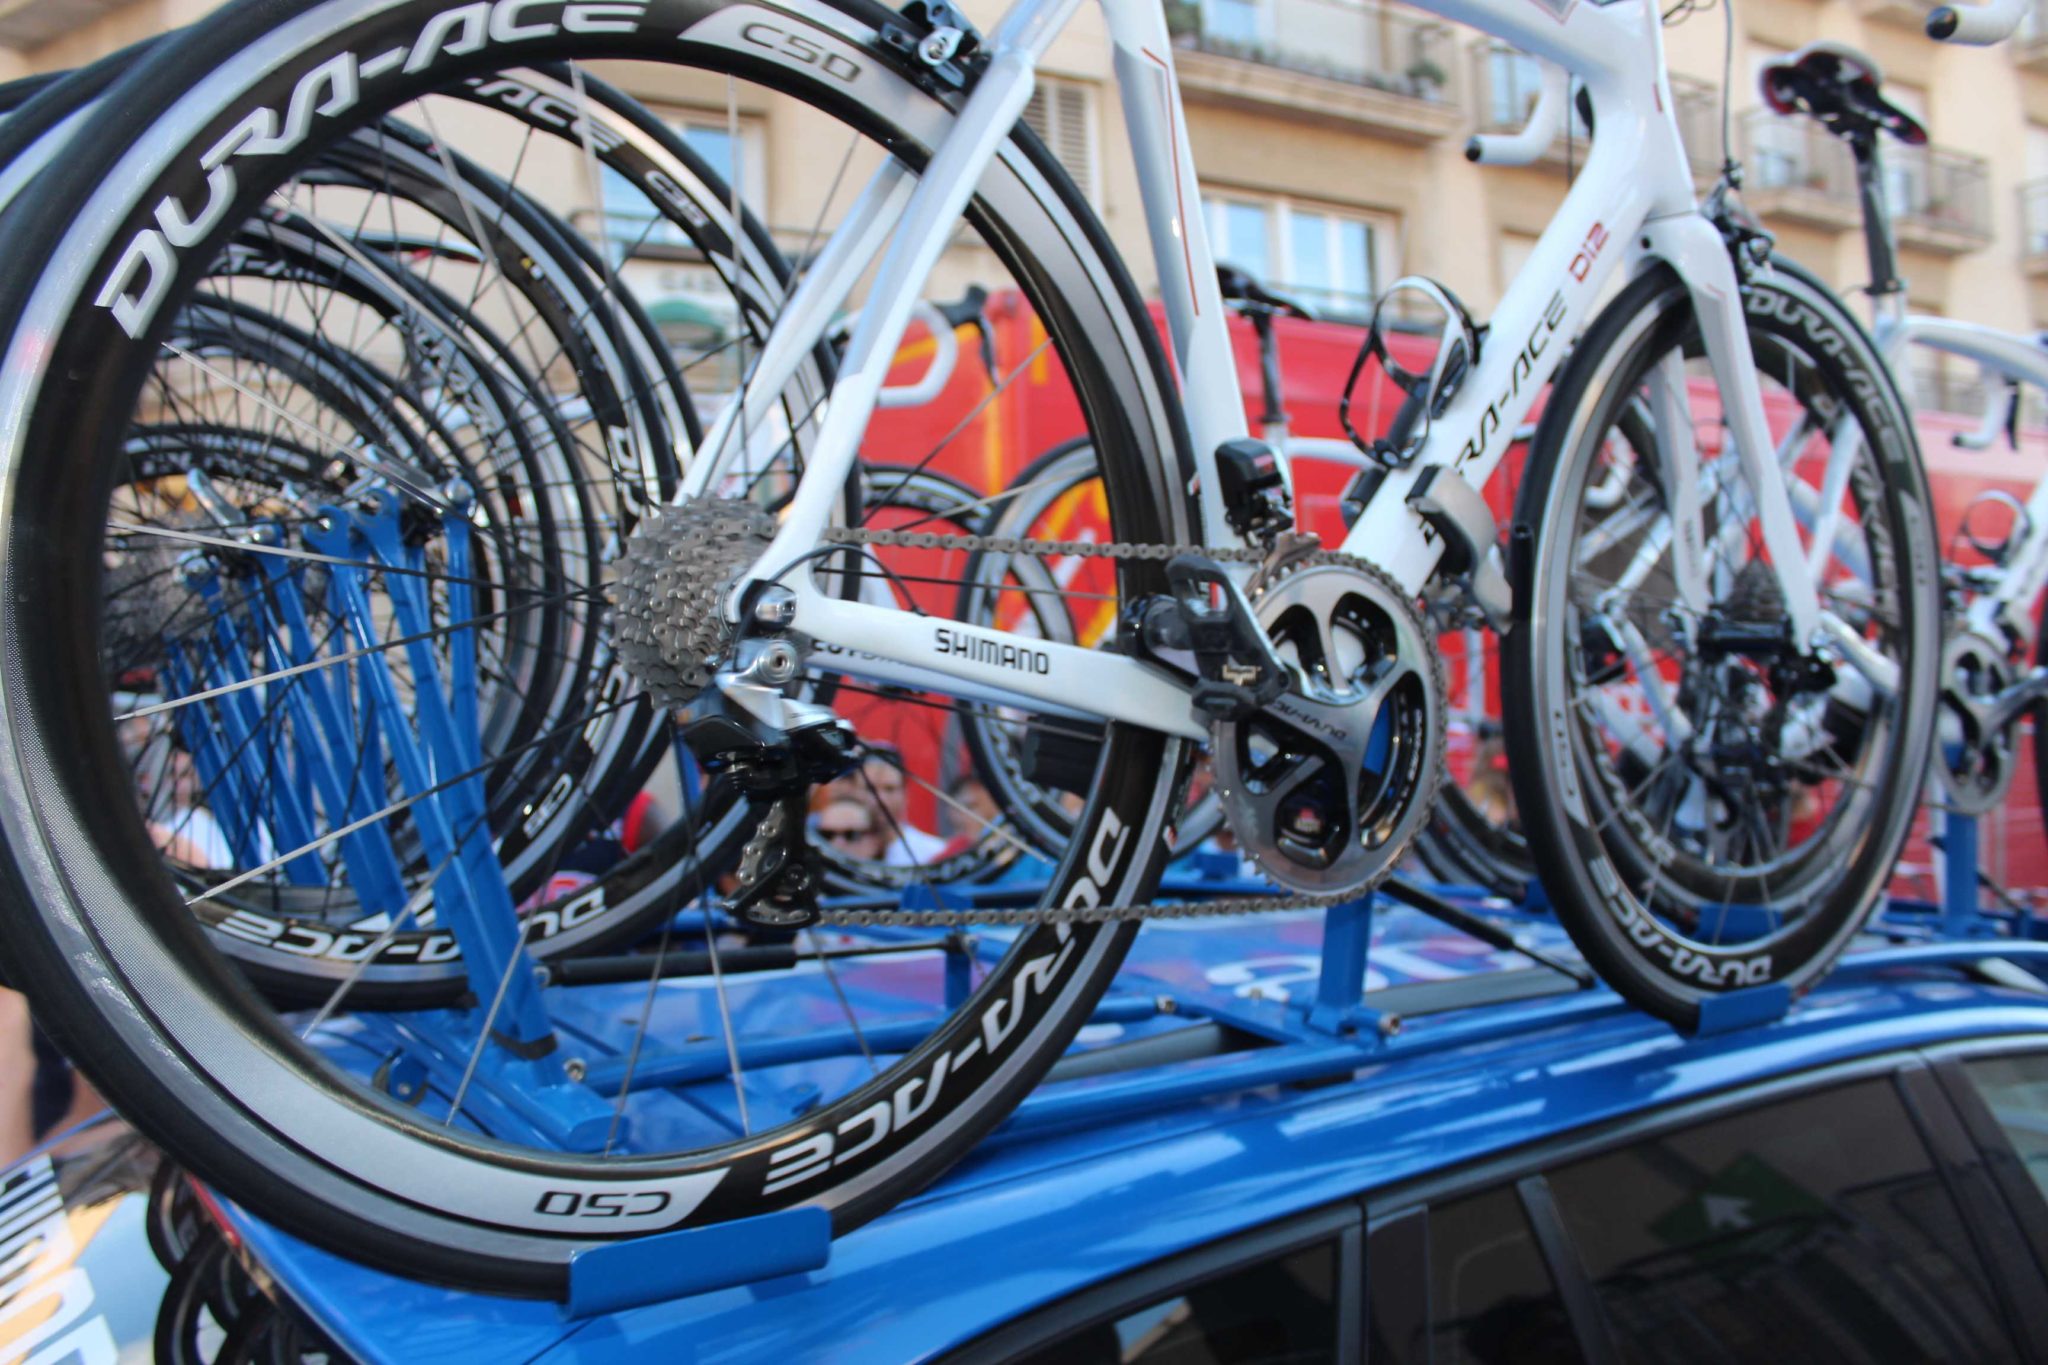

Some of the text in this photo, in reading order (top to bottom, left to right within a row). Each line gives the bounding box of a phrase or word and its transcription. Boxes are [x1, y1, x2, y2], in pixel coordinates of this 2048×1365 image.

[741, 21, 861, 83] C50
[95, 0, 646, 340] DURA-ACE
[1747, 284, 1905, 463] DURA-ACE
[934, 627, 1050, 676] SHIMANO
[1590, 855, 1773, 985] DURA-ACE
[761, 806, 1130, 1196] DURA-ACE
[534, 1189, 671, 1217] C50
